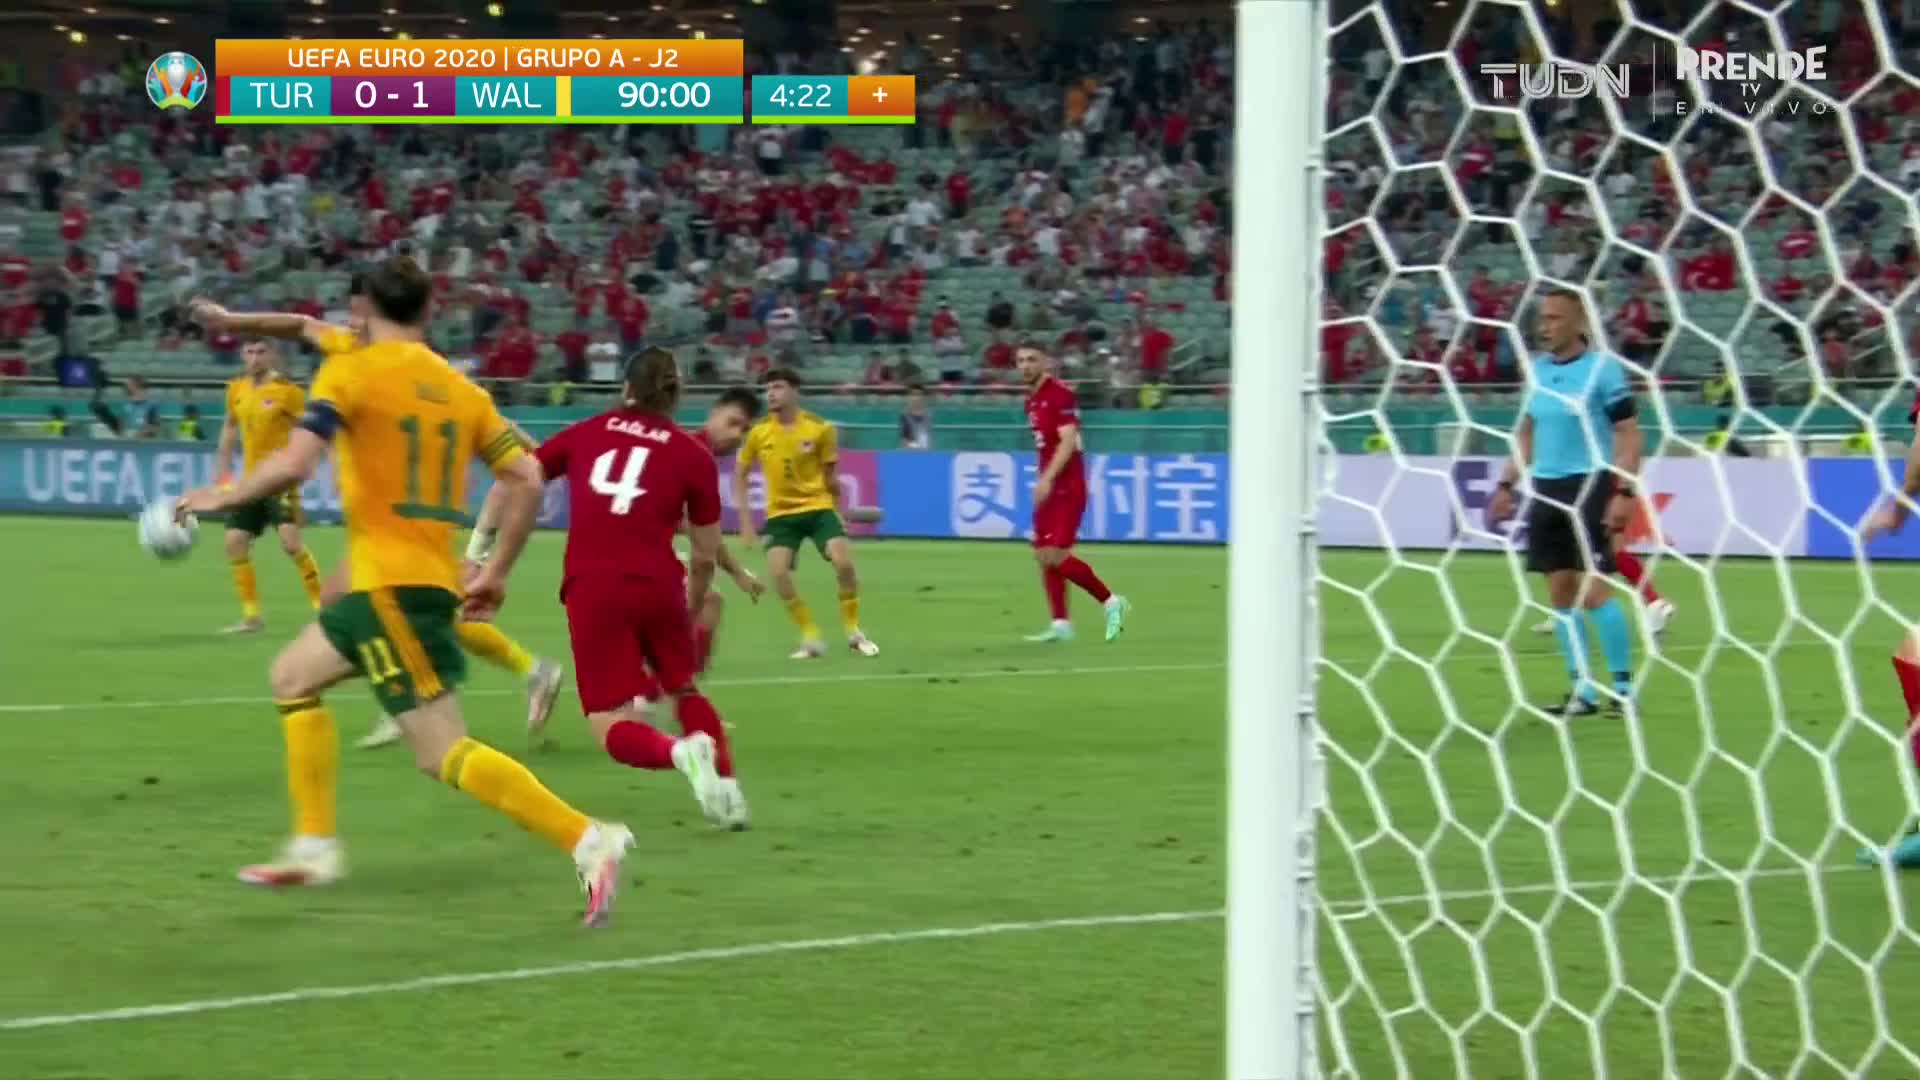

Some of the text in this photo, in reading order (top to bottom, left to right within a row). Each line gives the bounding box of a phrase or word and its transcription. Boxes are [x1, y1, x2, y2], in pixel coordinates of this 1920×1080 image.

[22, 448, 146, 503] UEFA
[588, 446, 651, 515] 4
[358, 637, 401, 684] 11
